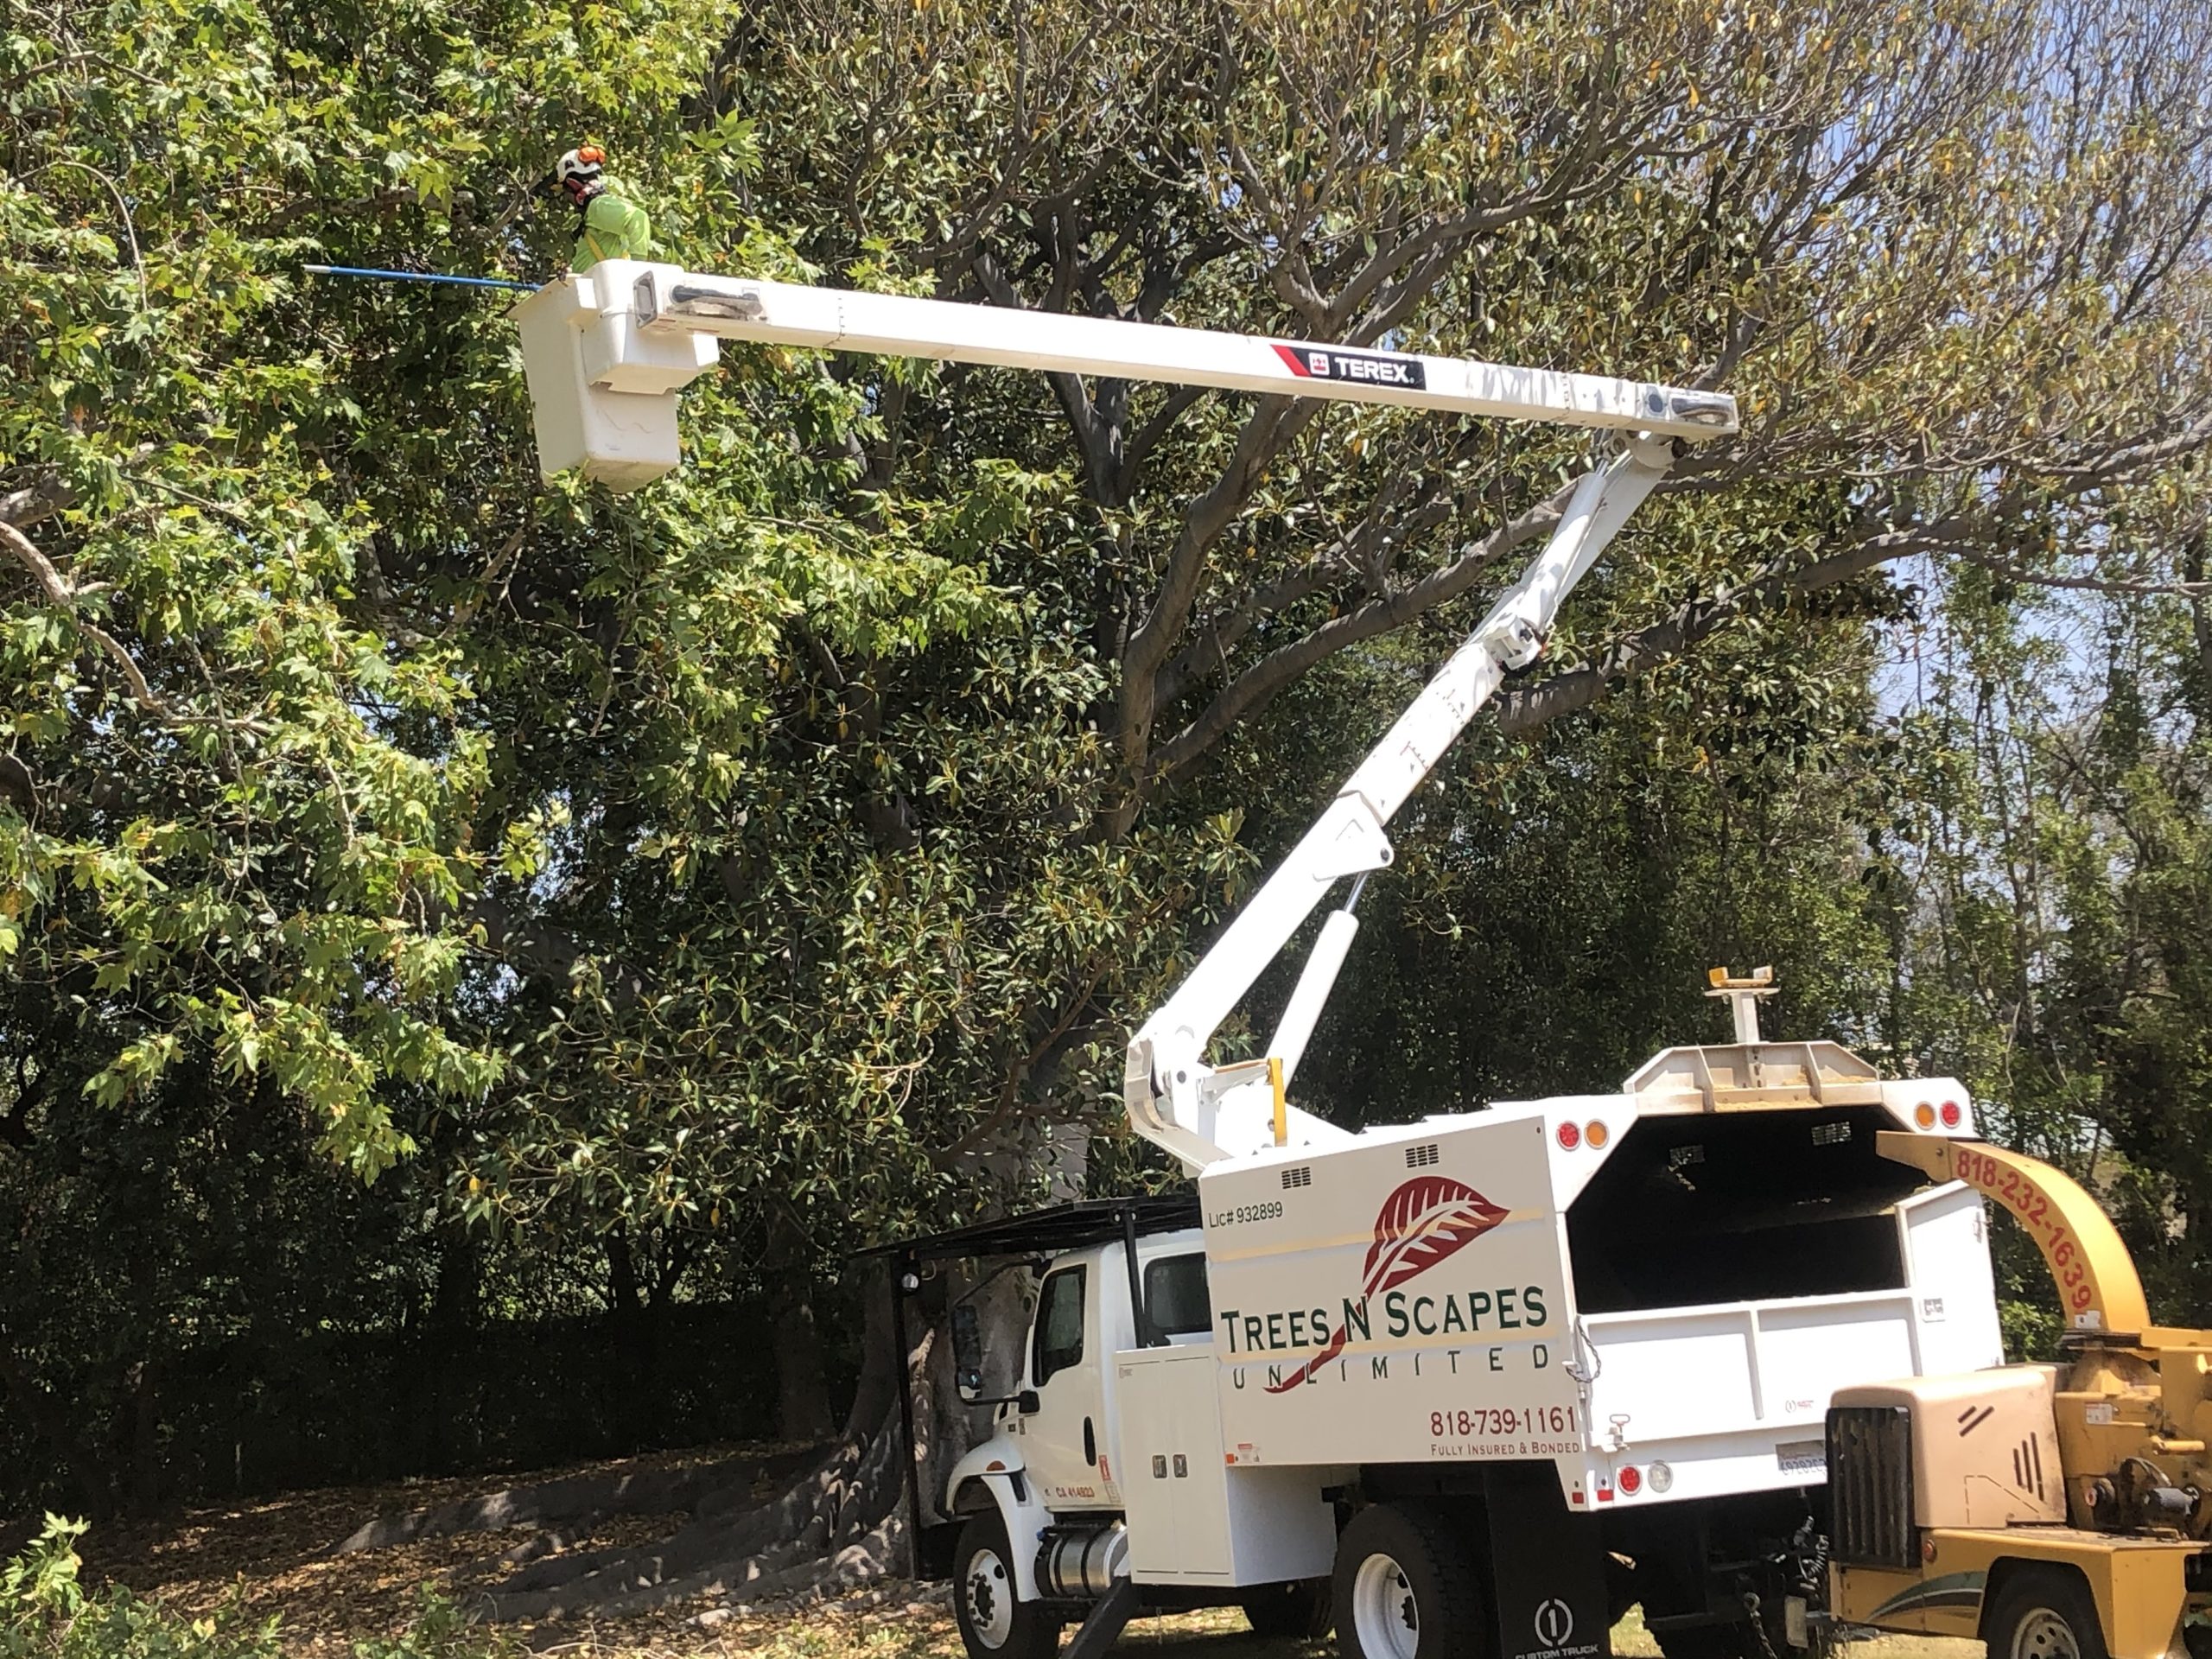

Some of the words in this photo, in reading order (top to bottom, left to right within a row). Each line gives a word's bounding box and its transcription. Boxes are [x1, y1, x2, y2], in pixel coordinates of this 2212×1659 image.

[1334, 356, 1410, 384] TEREX
[1236, 1201, 1283, 1224] 932899
[1957, 1150, 2092, 1309] 818-232-1639
[1342, 1295, 1372, 1342] N
[1232, 1344, 1548, 1389] UNLIMITED
[1430, 1406, 1576, 1437] 818-739-1161
[1431, 1444, 1463, 1456] FULLY
[1467, 1443, 1516, 1456] INSURED
[1519, 1442, 1528, 1454] &
[1531, 1441, 1580, 1454] BONDED
[1561, 1643, 1599, 1657] TRUCK
